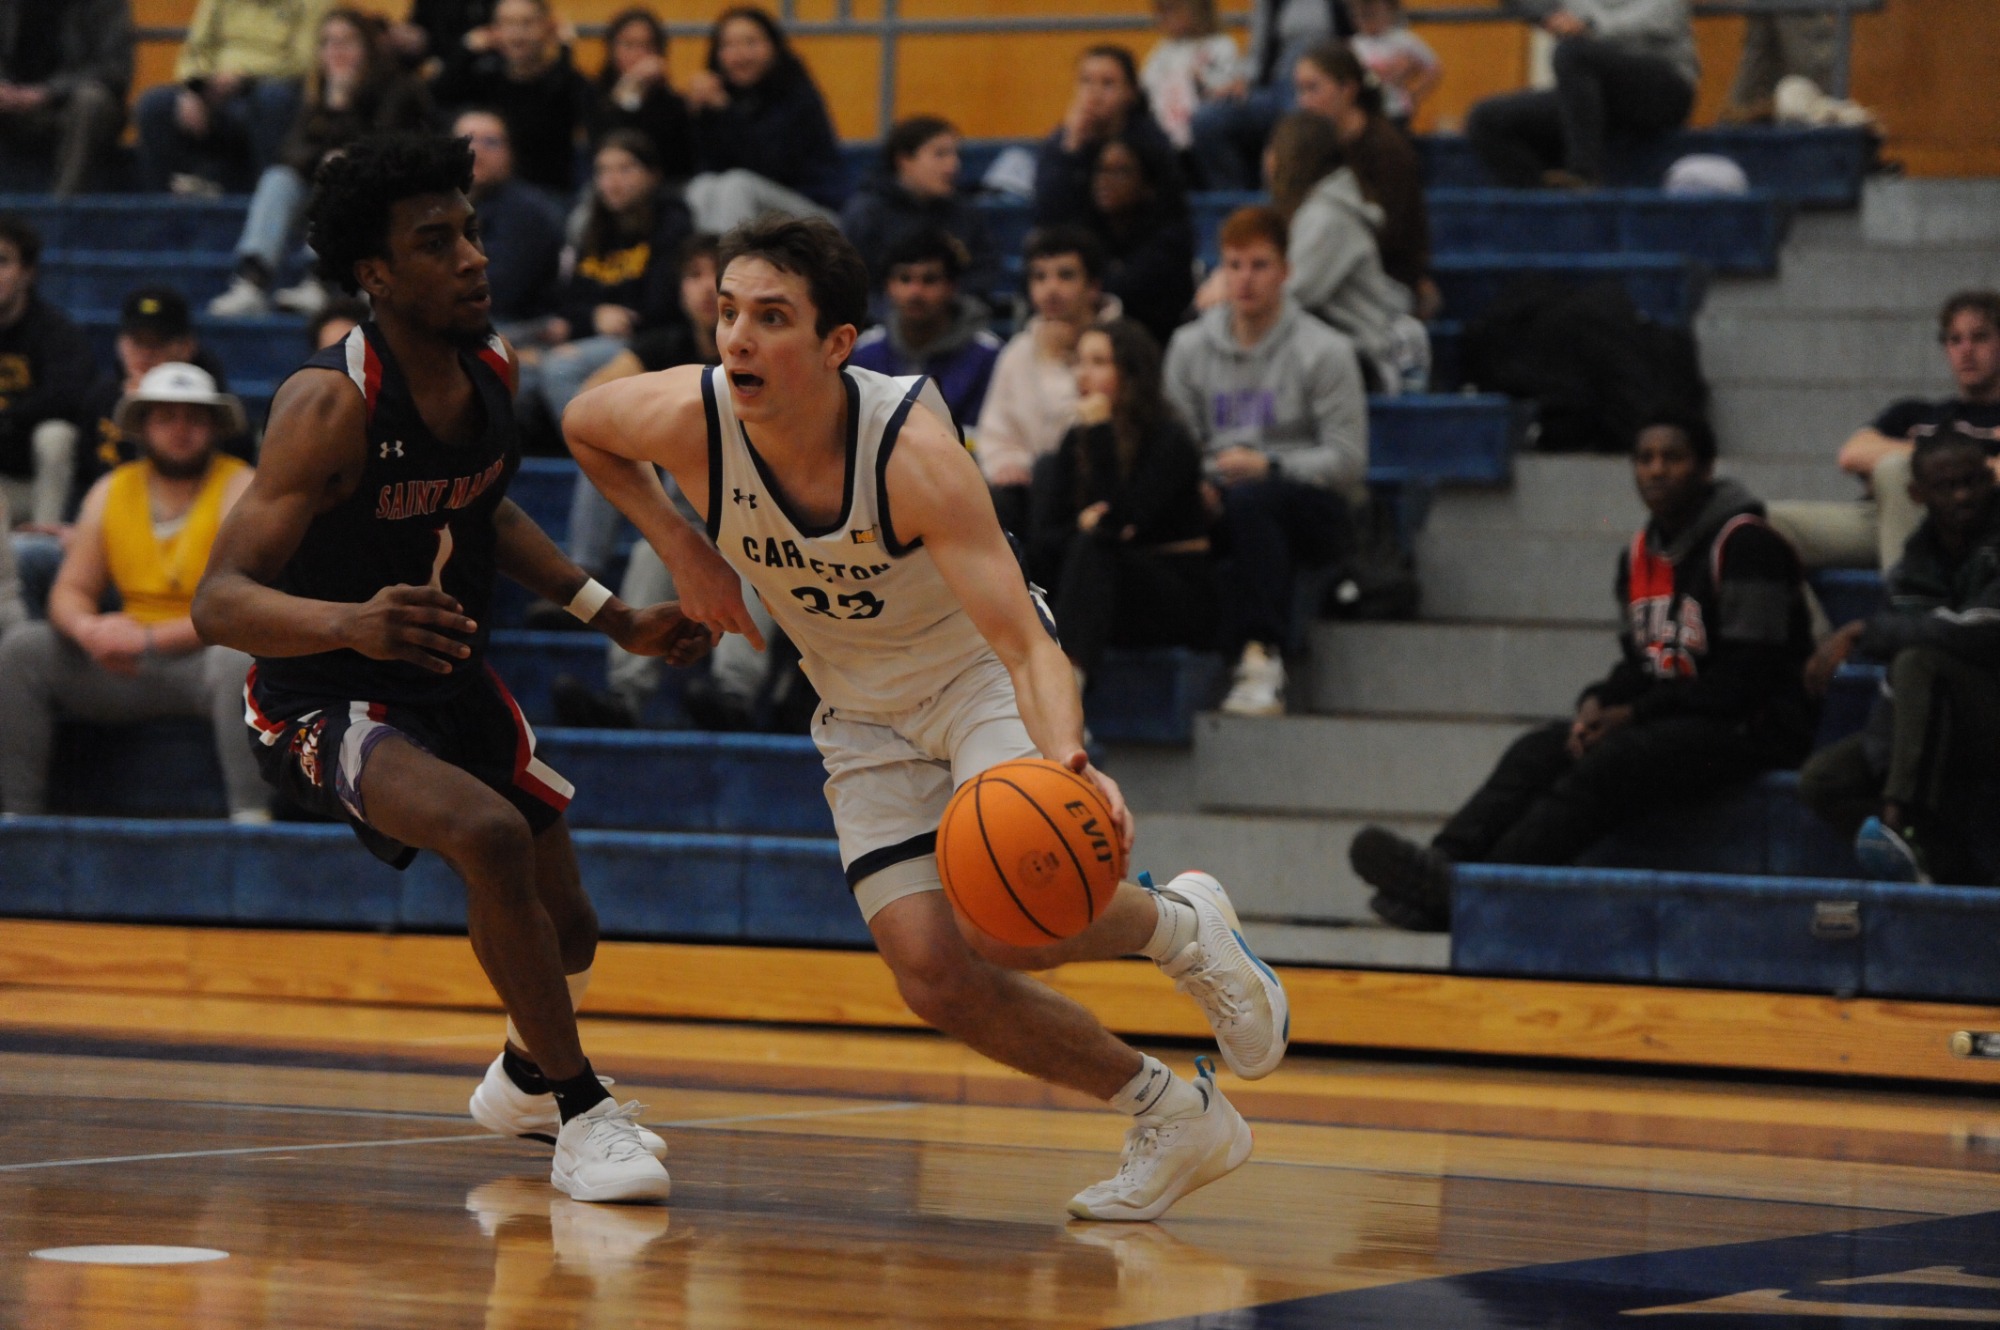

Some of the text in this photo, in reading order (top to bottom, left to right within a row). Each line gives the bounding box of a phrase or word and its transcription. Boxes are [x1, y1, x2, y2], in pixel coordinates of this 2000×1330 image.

[376, 479, 448, 520] SAINT
[742, 536, 891, 583] CARETON
[1064, 800, 1113, 862] EVO
